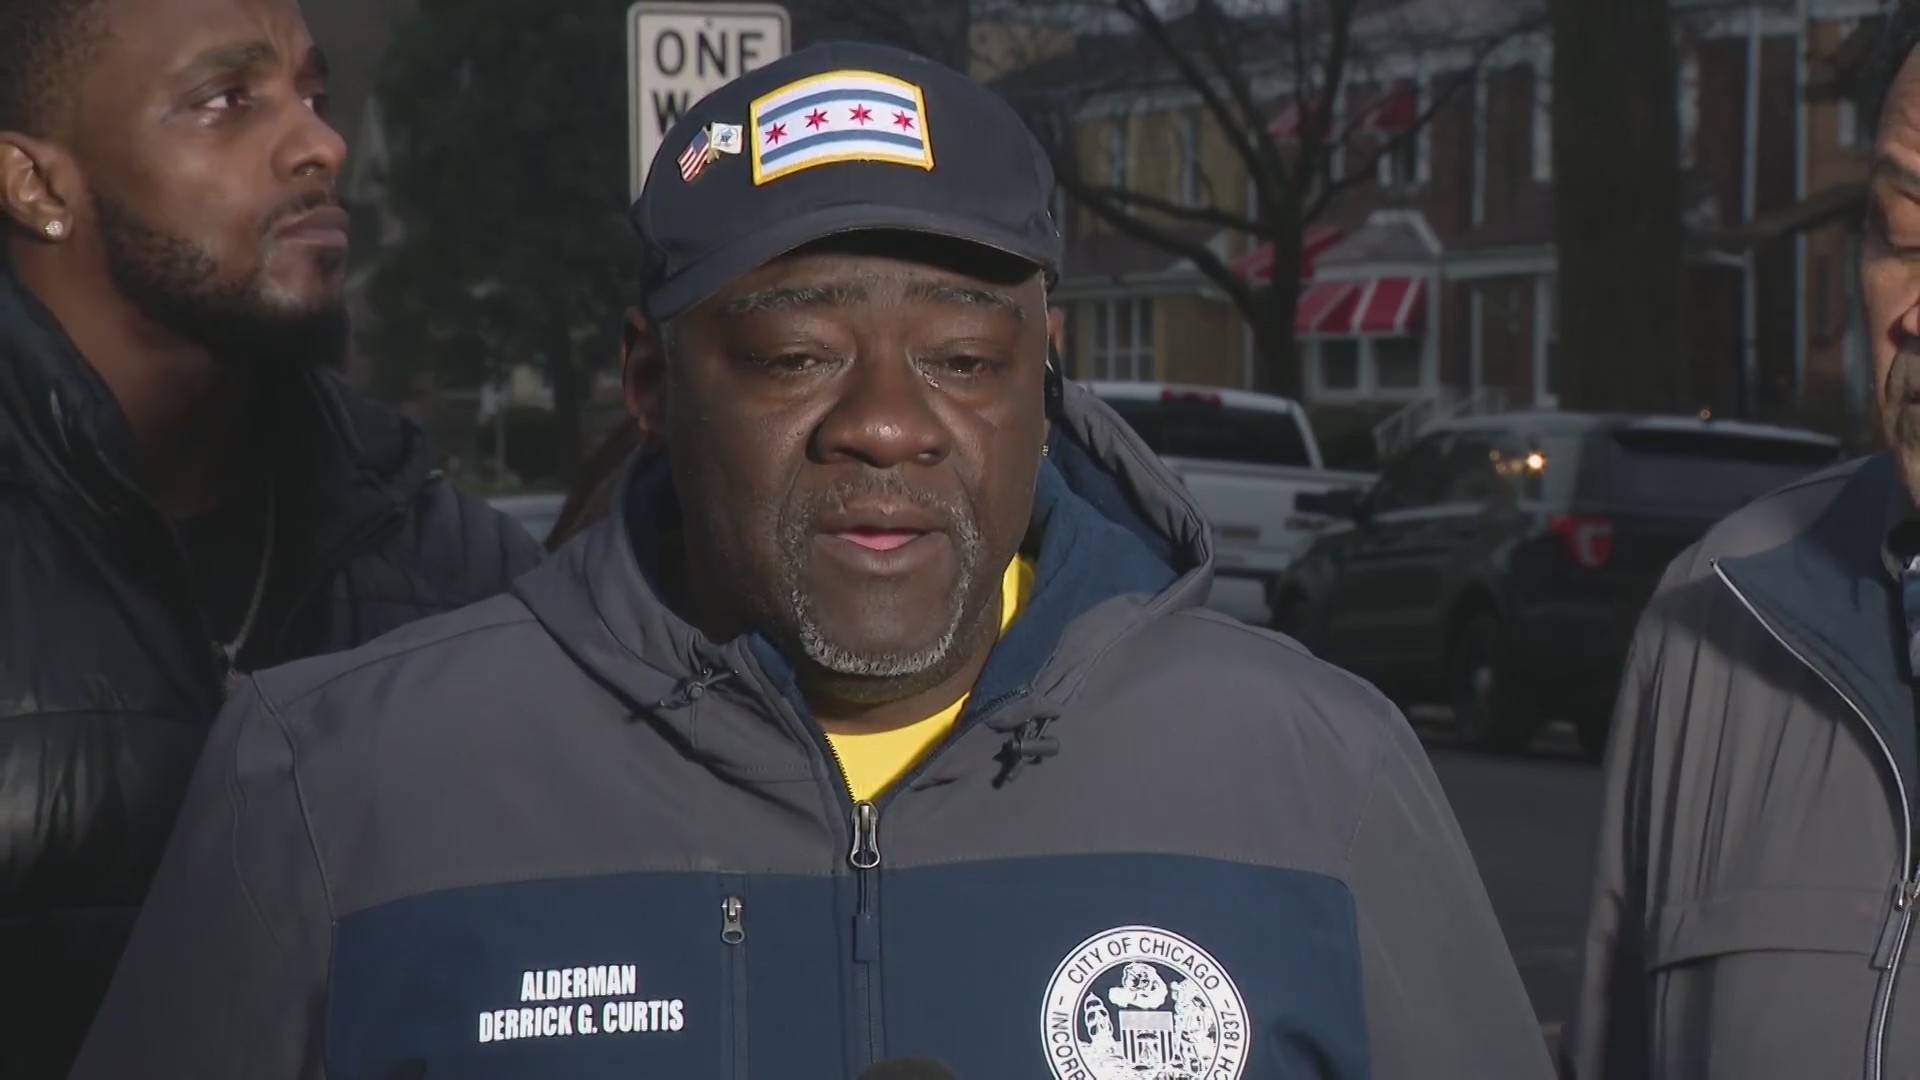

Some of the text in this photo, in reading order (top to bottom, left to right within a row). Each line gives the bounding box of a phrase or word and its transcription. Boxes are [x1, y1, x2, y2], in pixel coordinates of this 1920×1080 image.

[656, 30, 764, 78] ONE
[520, 965, 636, 1002] ALDERMAN
[1067, 937, 1220, 990] CITY OF CHICAGO
[479, 999, 684, 1043] DERRICK G. CURTIS
[1220, 1011, 1240, 1050] 1837
